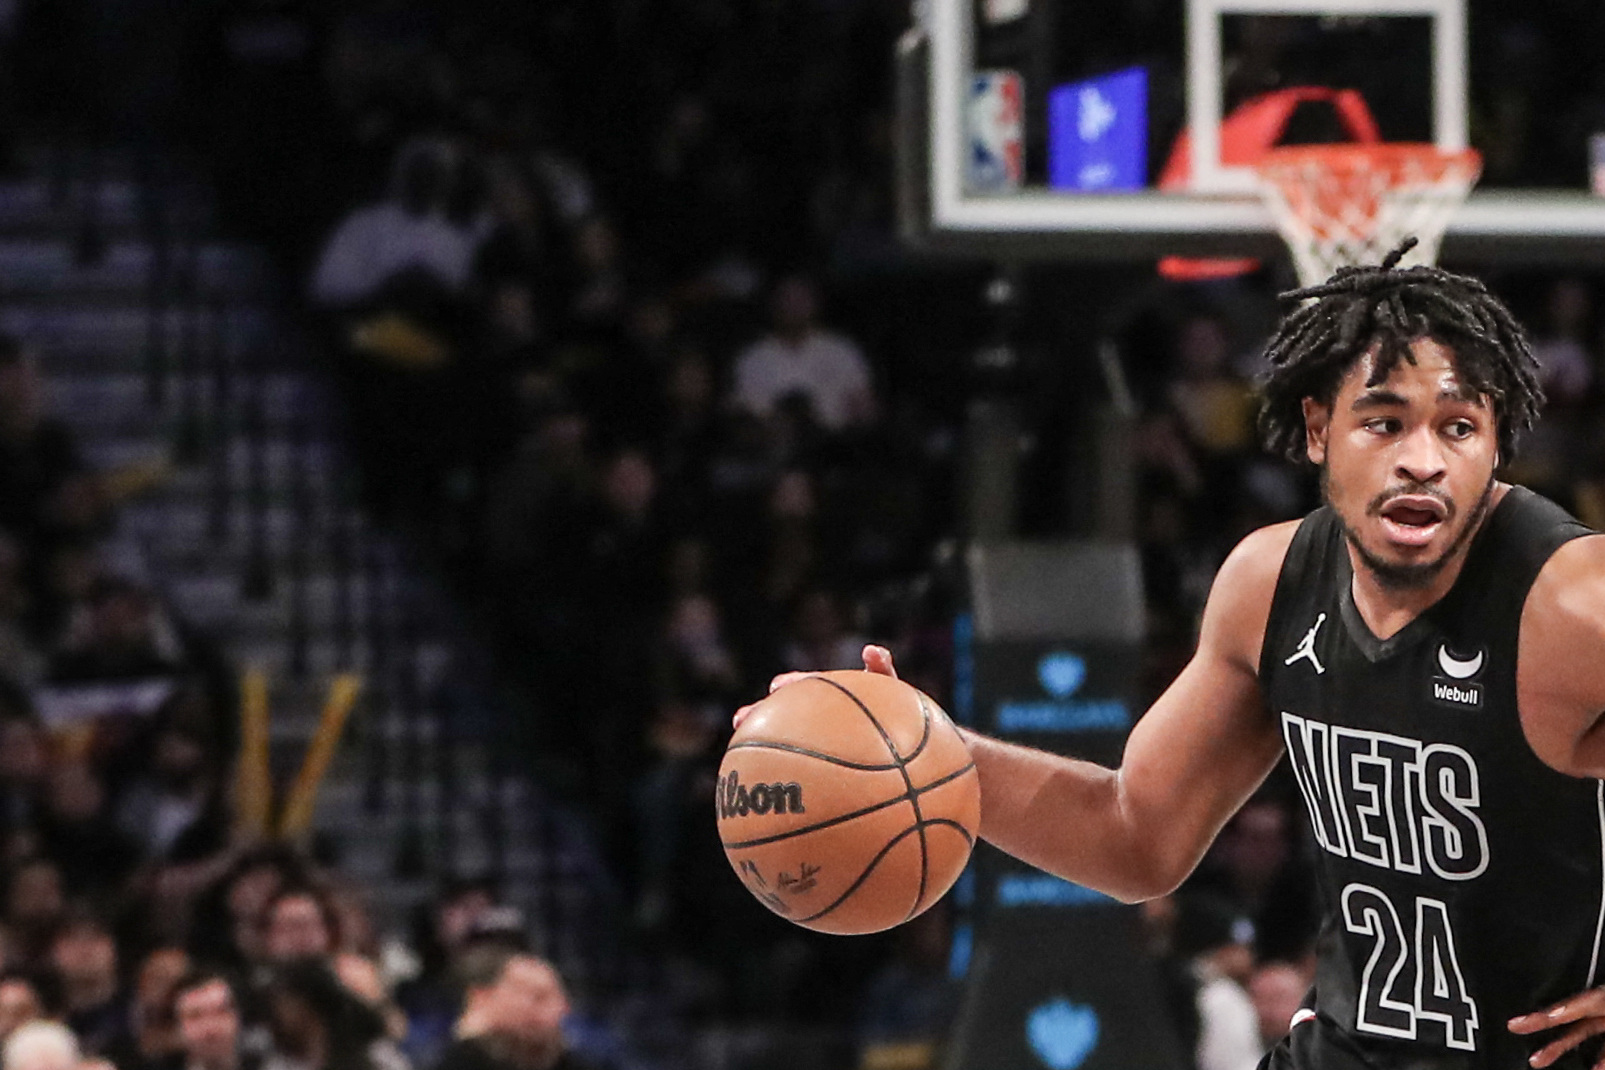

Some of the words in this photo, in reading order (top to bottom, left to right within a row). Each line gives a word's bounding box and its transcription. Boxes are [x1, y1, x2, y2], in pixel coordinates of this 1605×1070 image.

[1434, 683, 1478, 705] Webull
[716, 770, 805, 820] ilson
[1281, 711, 1491, 880] NETS
[1341, 883, 1479, 1051] 24
